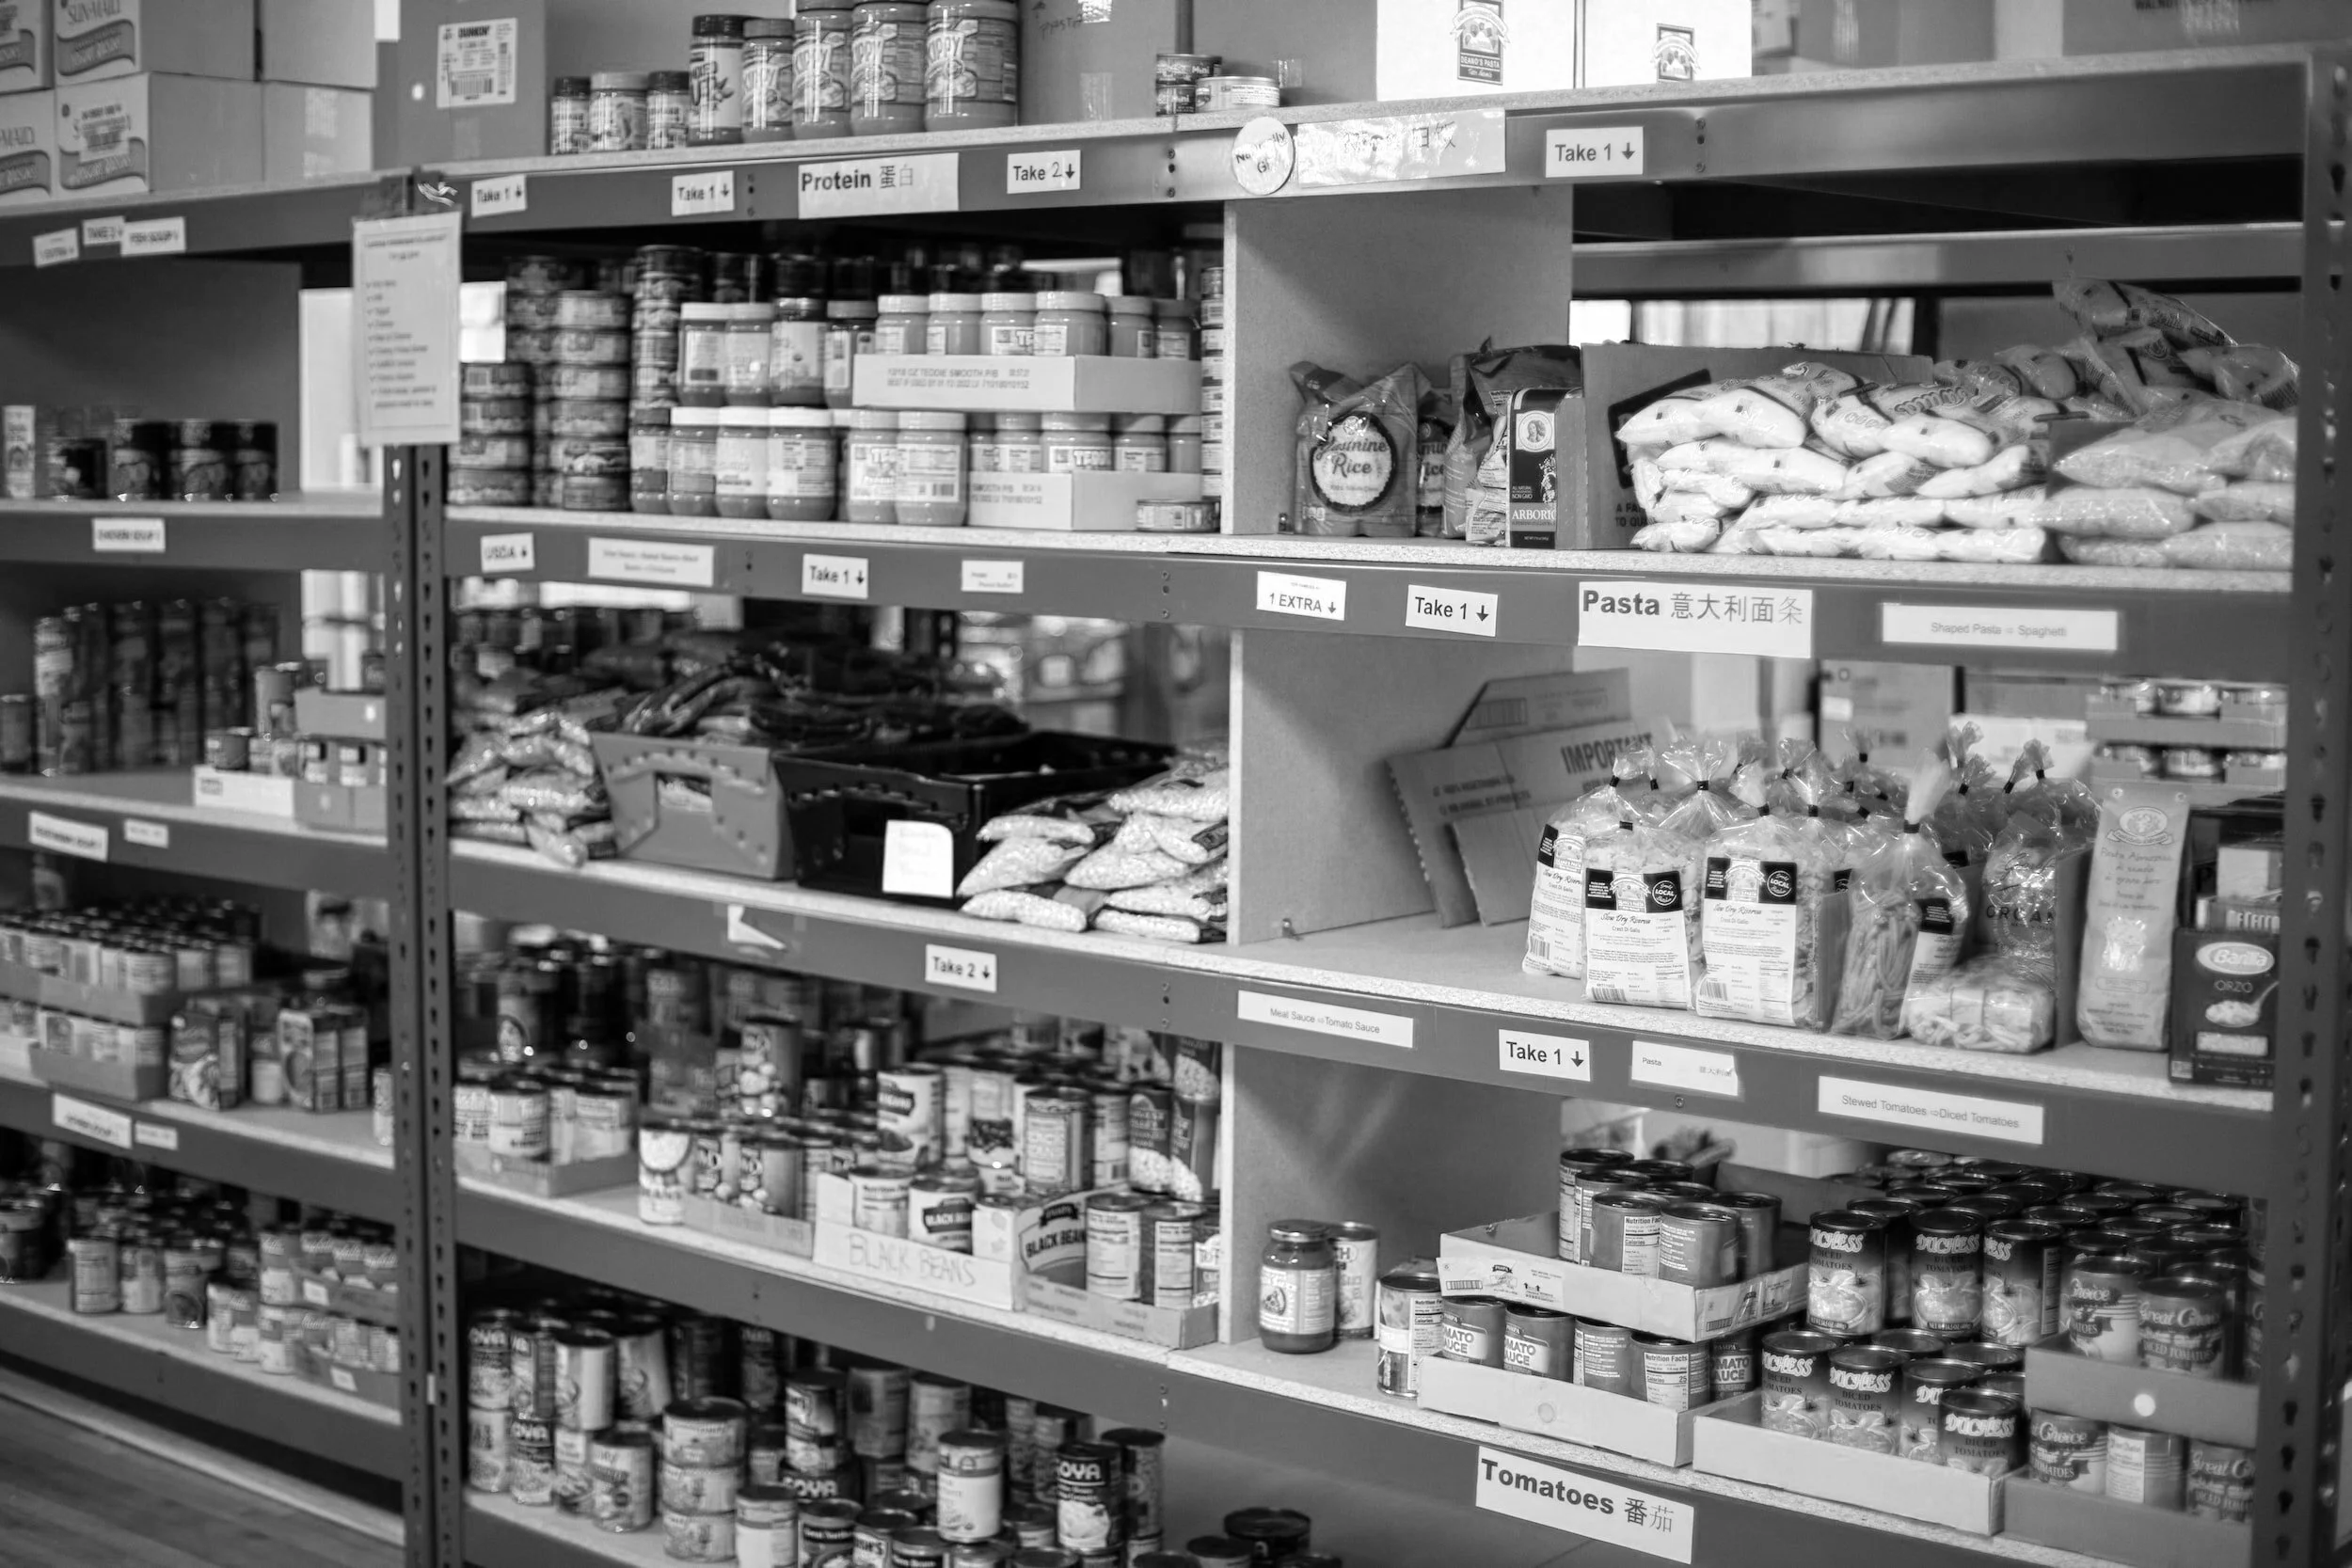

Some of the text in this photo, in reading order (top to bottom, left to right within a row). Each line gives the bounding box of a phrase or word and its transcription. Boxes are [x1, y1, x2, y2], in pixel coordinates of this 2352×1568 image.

[1484, 57, 1501, 69] PASTA
[1555, 143, 1612, 163] Take 1
[802, 164, 914, 192] Protein 蛋白
[1013, 162, 1063, 182] Take 2
[677, 184, 714, 201] Take 1
[1331, 453, 1373, 478] Rice
[810, 564, 849, 584] Take 1
[1269, 593, 1322, 612] 1 EXTRA
[1415, 596, 1467, 619] Take 1
[1582, 590, 1804, 625] Pasta 意大利面条
[1931, 622, 2067, 640] Shaped Pasta Spaghetti
[1561, 733, 1652, 774] IMPORTT
[1655, 888, 1675, 897] LOCAL
[1770, 877, 1789, 889] LOCAL
[932, 956, 975, 977] Take 2
[2213, 948, 2268, 969] Barilla
[2214, 979, 2253, 992] ORZO
[1291, 1011, 1315, 1022] Sauce
[1325, 1017, 1353, 1029] Tomato
[1355, 1022, 1380, 1034] Sauce
[1506, 1041, 1561, 1065] Take 1
[1643, 1056, 1662, 1067] Pasta
[1841, 1094, 2019, 1129] Stewed Tomatoes Diced Tomatoes
[925, 1213, 953, 1227] BLACK
[1025, 1228, 1087, 1259] BLACK BEAN
[1915, 1234, 1979, 1255] DUCHESS
[849, 1232, 976, 1288] BLACK BEANS
[1926, 1263, 1974, 1273] TOMATOES
[1933, 1255, 1963, 1264] DICED
[1442, 1325, 1474, 1344] MATO
[1505, 1339, 1536, 1356] MATO
[1645, 1354, 1669, 1362] Nutrition
[1716, 1356, 1750, 1370] MATO
[1830, 1367, 1892, 1393] DUCHESS
[1835, 1399, 1882, 1411] TOMATOES
[1841, 1390, 1871, 1402] DICED
[1945, 1413, 2014, 1437] DUCHESS
[2039, 1420, 2087, 1445] Choice
[1965, 1437, 1996, 1448] DICED
[1955, 1447, 2007, 1458] TOMATOES
[1058, 1461, 1101, 1480] OYA
[1481, 1458, 1675, 1533] Tomatoes 番茄
